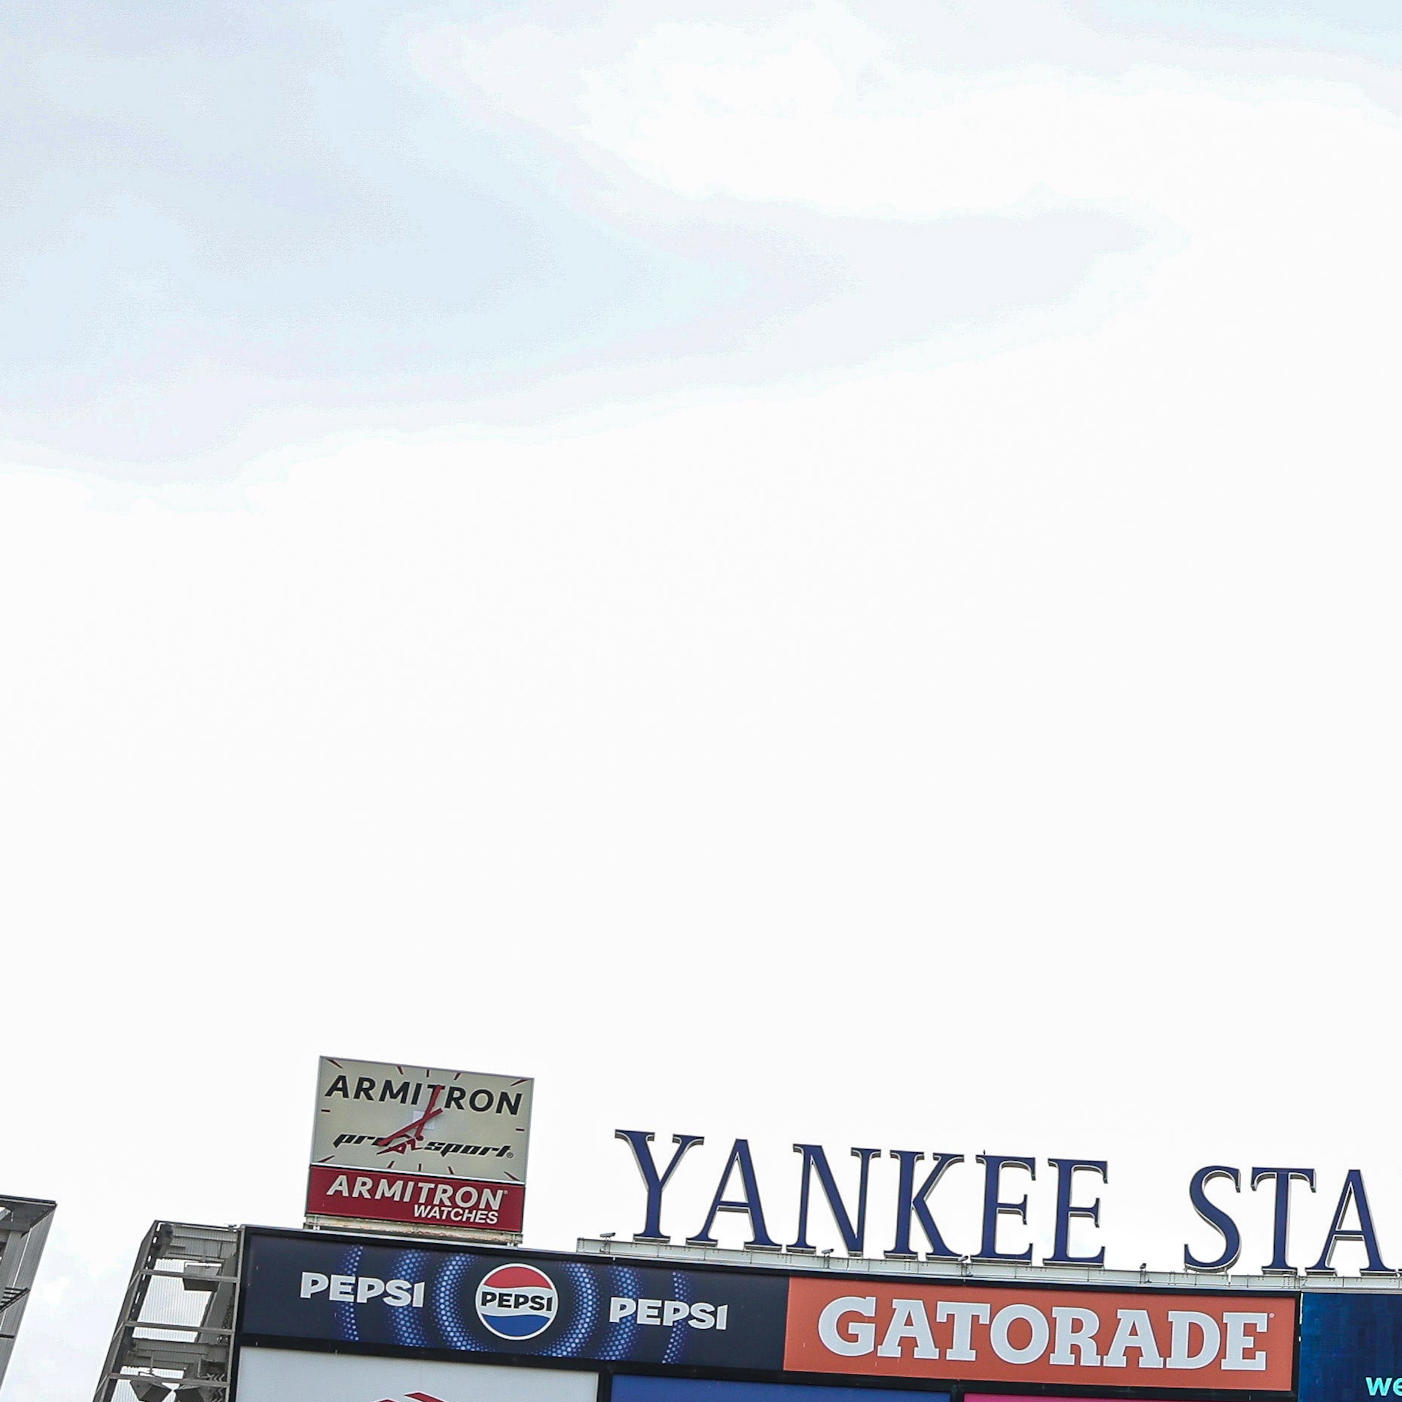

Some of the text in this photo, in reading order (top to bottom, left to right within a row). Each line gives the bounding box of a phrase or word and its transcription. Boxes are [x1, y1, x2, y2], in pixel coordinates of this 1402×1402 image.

[324, 1074, 523, 1116] ARMITRON
[424, 1140, 511, 1157] sport
[326, 1175, 504, 1211] ARMITRON
[615, 1129, 1108, 1268] YANKEE
[413, 1204, 499, 1225] WATCHES
[300, 1271, 729, 1332] PEPSI PEPSI PEPSI
[817, 1296, 1268, 1372] GATORADE
